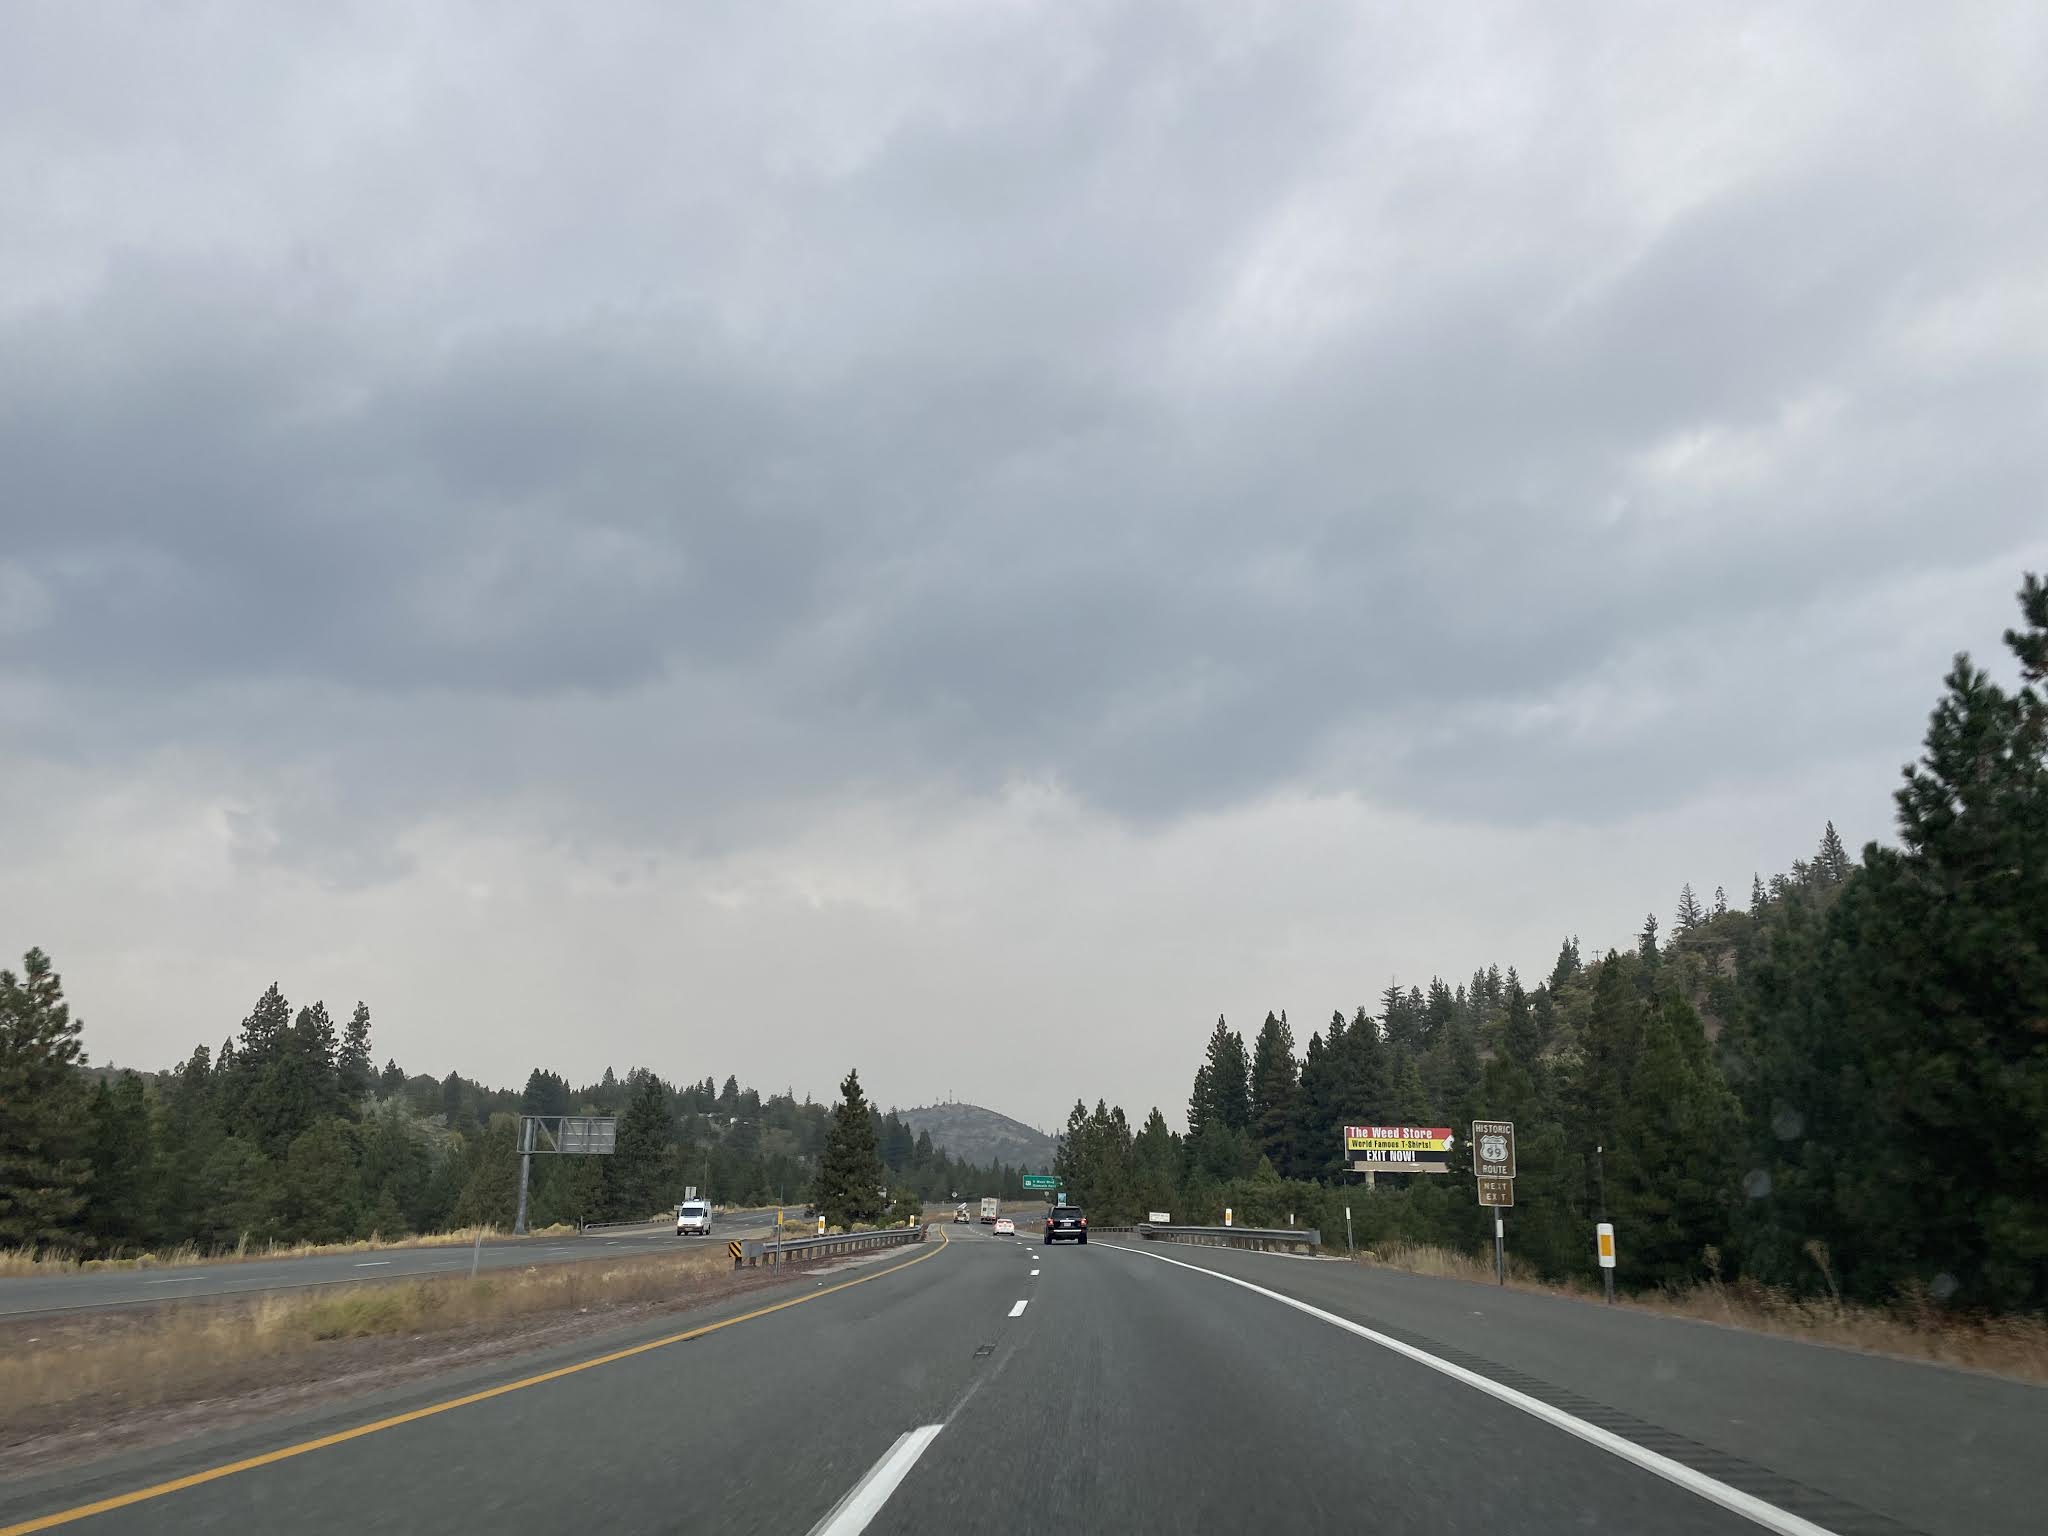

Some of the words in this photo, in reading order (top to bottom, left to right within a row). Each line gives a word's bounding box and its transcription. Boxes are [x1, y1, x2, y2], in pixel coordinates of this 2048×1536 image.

[1350, 1127, 1368, 1138] The
[1372, 1127, 1399, 1138] Weed
[1403, 1128, 1433, 1139] Store
[1475, 1124, 1511, 1134] HISTORIC
[1351, 1140, 1372, 1148] World
[1374, 1140, 1399, 1148] Famous
[1401, 1140, 1432, 1149] T-Shirts!
[1366, 1150, 1387, 1161] EXIT
[1390, 1150, 1416, 1162] NOW!
[1486, 1147, 1502, 1158] 99
[1482, 1165, 1507, 1174] ROUTE
[1486, 1192, 1506, 1201] EXT
